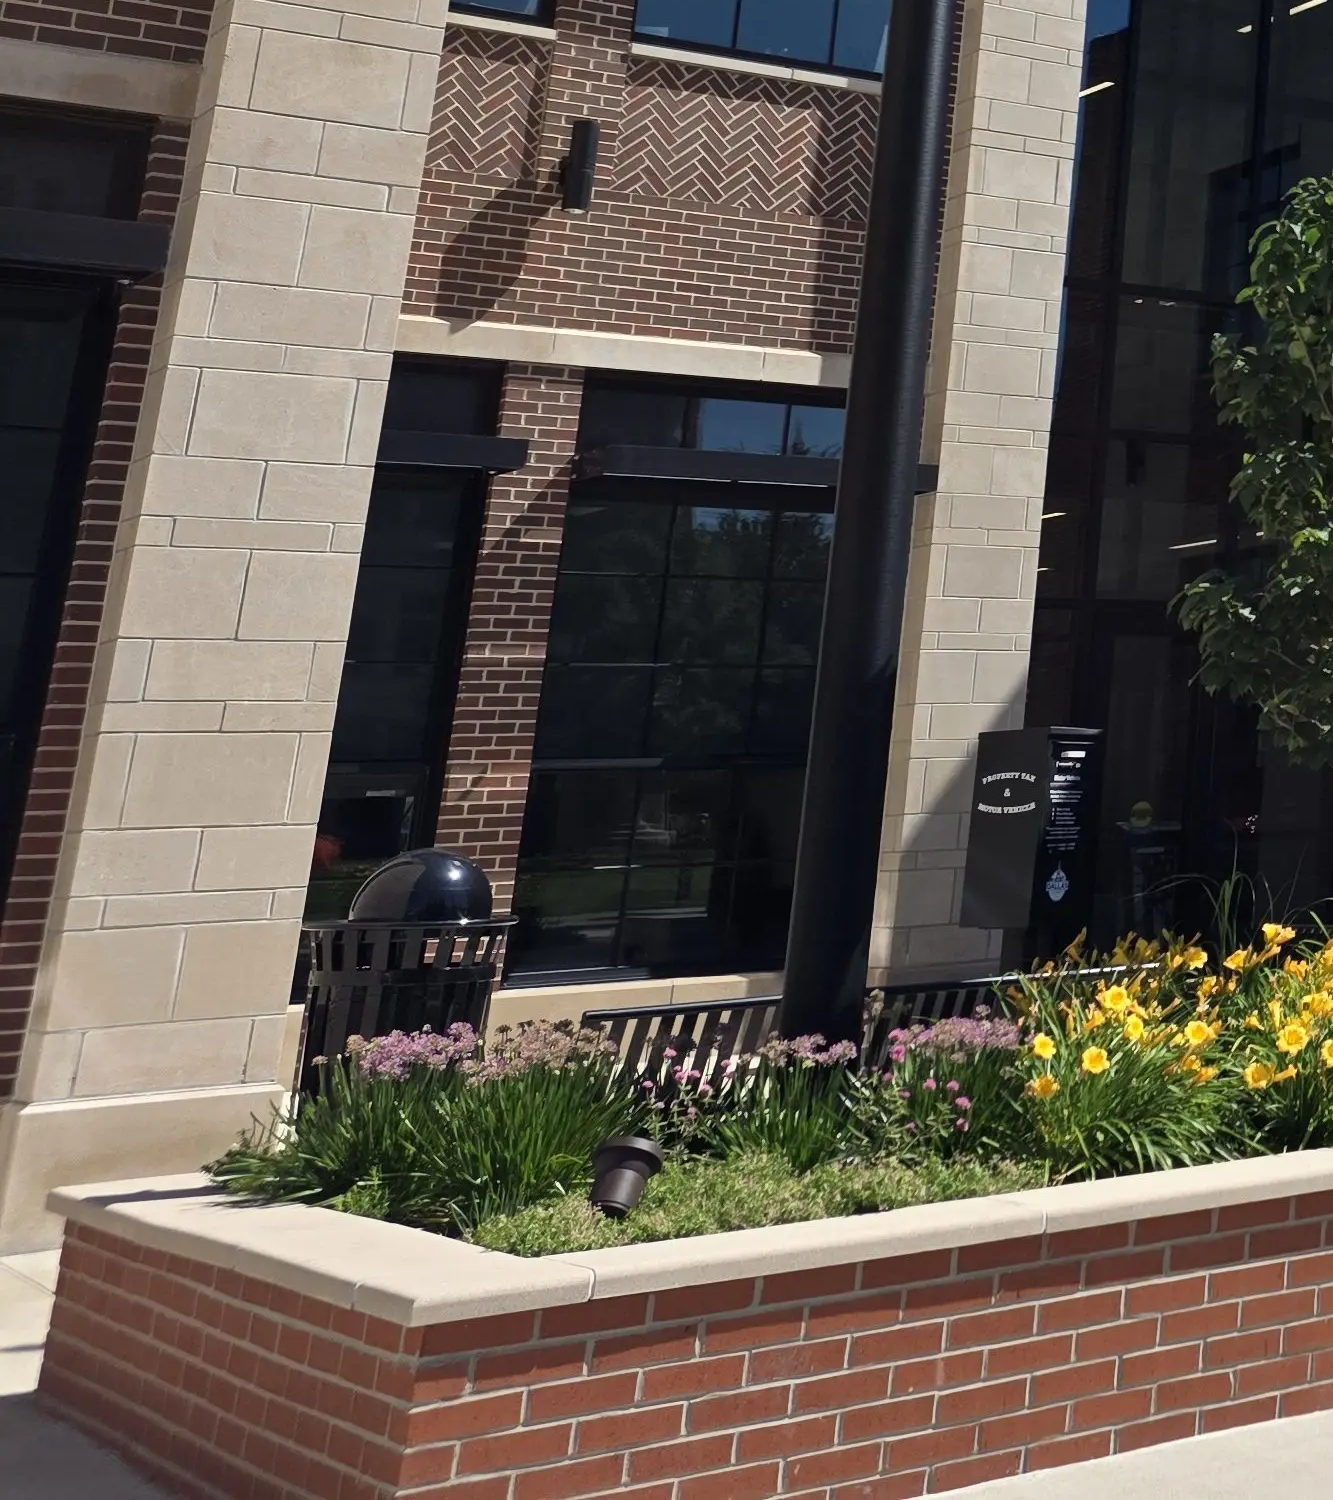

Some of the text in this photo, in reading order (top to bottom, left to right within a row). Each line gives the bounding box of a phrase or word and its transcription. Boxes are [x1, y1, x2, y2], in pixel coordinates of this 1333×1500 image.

[982, 772, 1037, 785] PROPERTY TAX
[1003, 787, 1011, 798] &
[977, 802, 1002, 814] MOTOR
